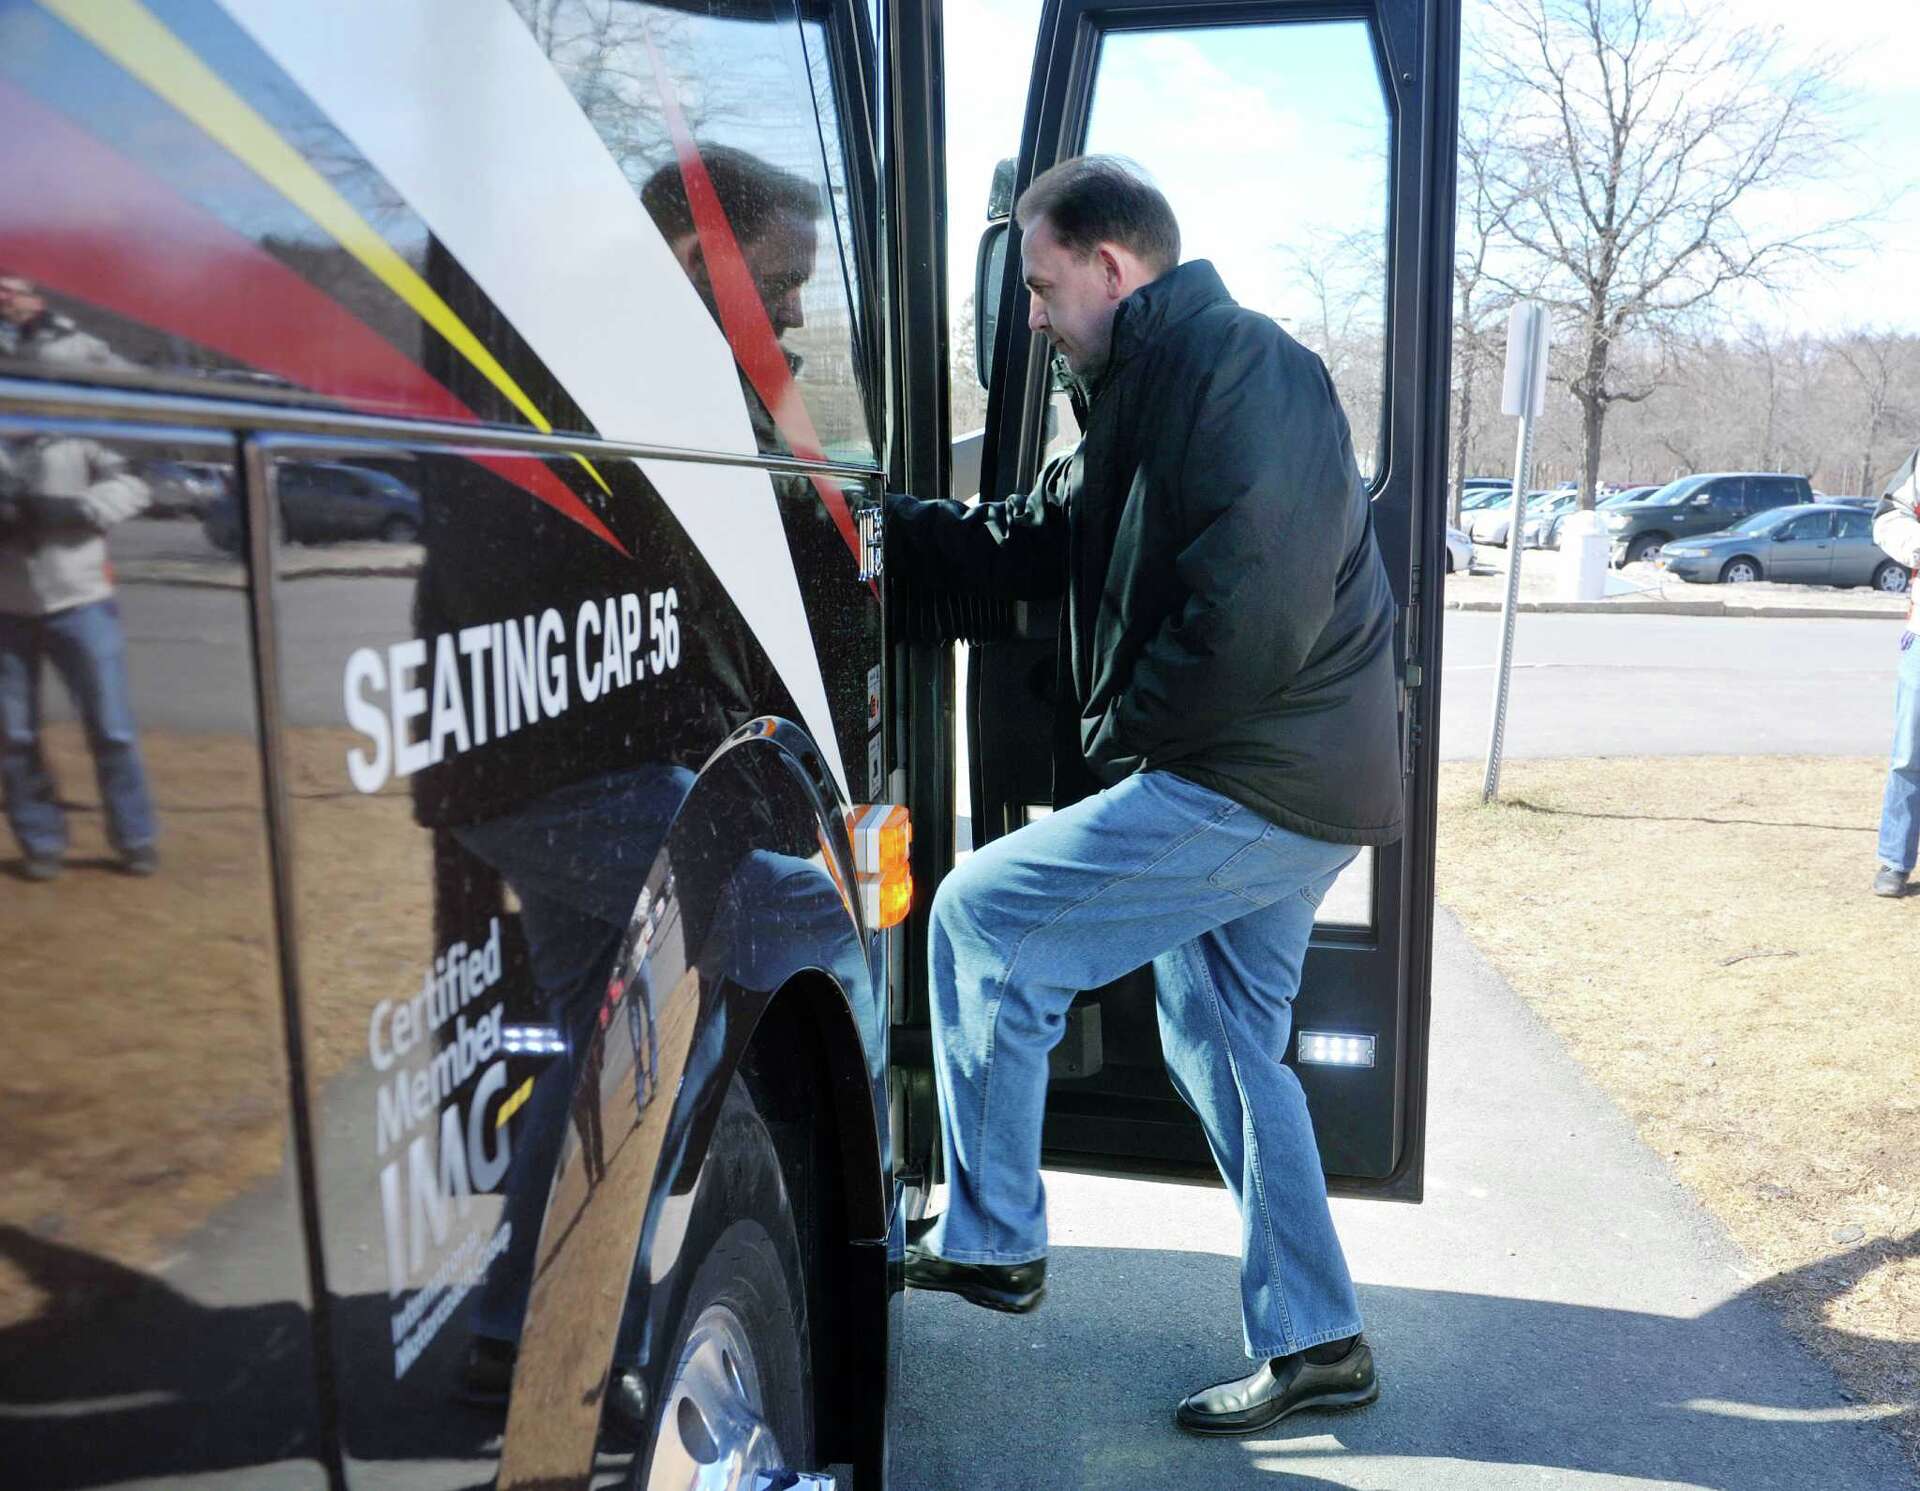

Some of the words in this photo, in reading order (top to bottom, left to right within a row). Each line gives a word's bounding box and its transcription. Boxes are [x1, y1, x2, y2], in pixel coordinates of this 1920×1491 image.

[343, 607, 568, 795] SEATING
[650, 587, 681, 676] 56
[368, 916, 502, 1072] Certified
[376, 1003, 504, 1156] Member
[380, 1061, 513, 1301] IMG
